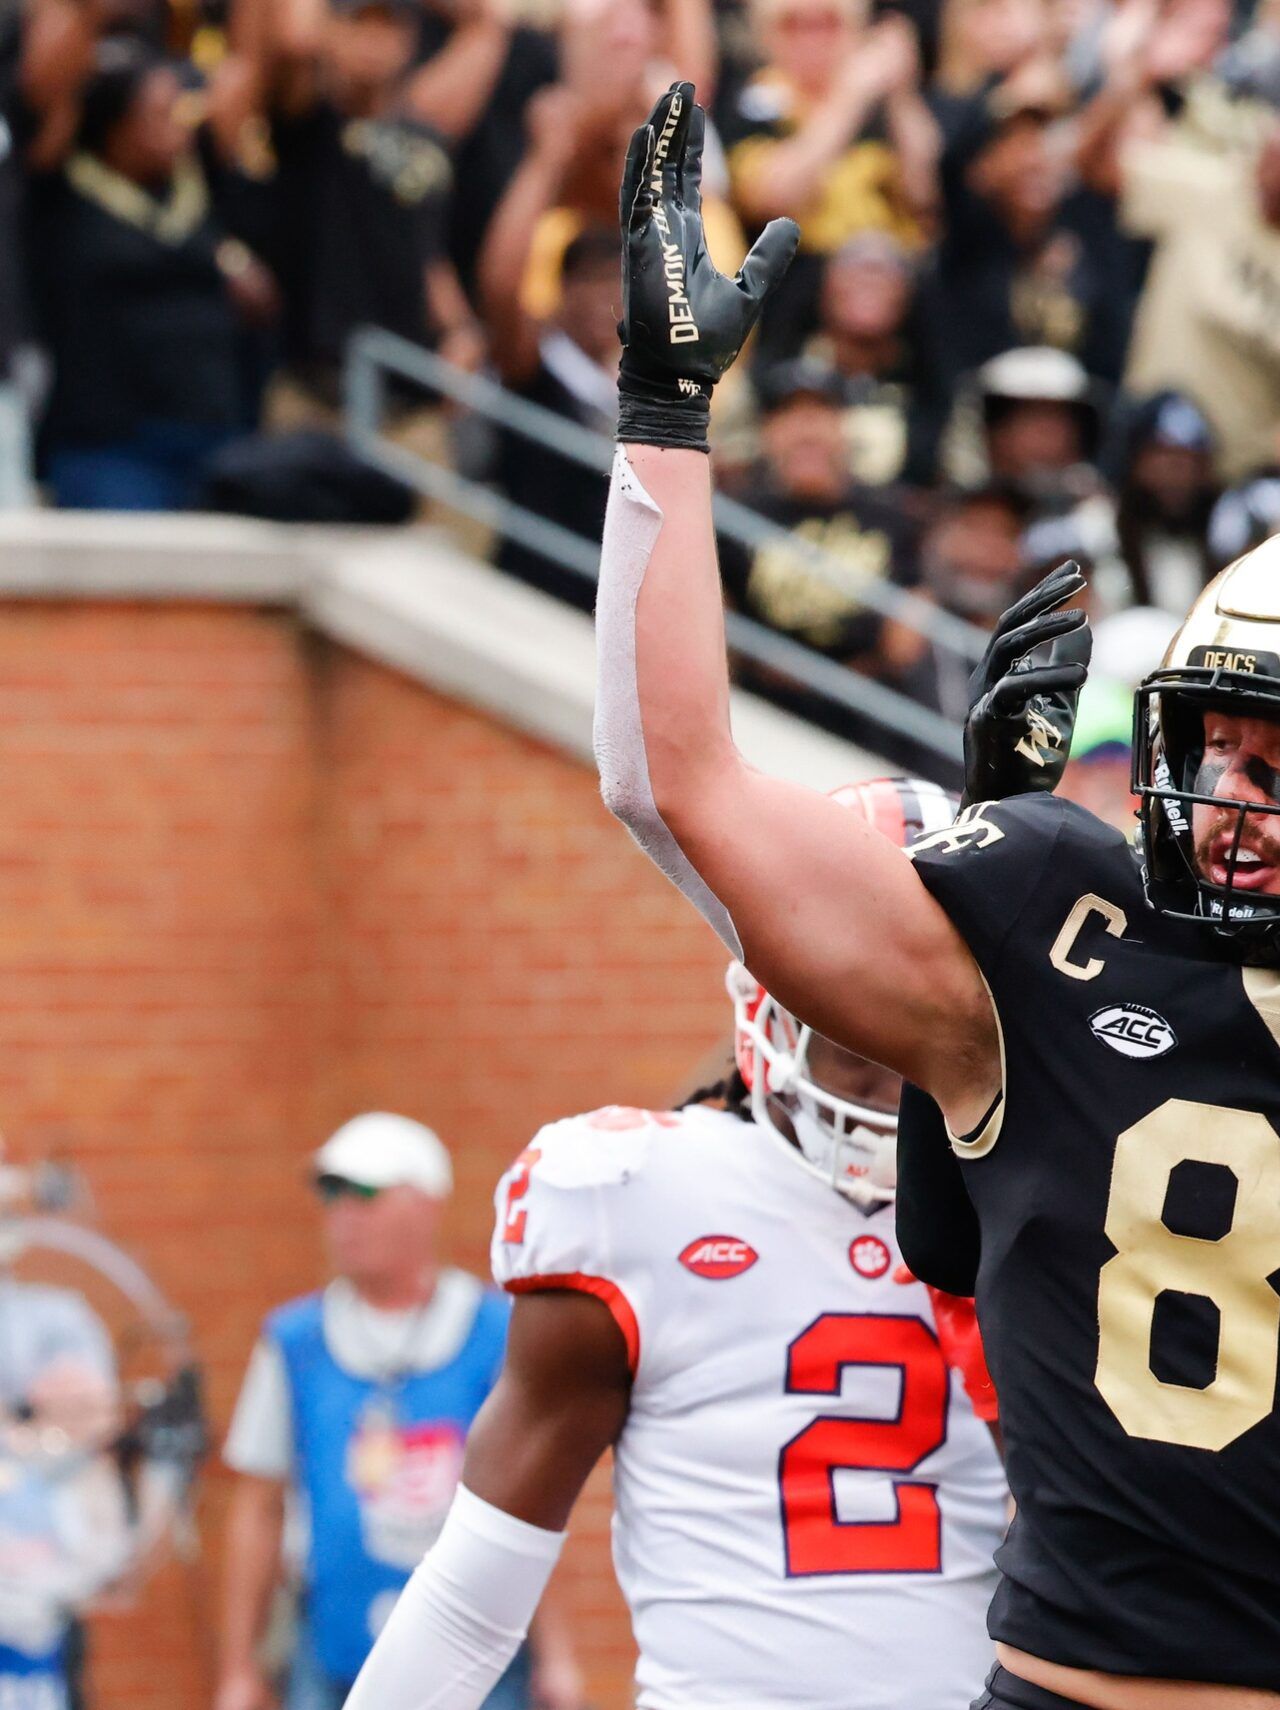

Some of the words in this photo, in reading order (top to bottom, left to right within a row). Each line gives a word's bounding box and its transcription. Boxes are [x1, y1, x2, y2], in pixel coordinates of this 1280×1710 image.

[661, 238, 700, 344] DEMON
[1203, 651, 1257, 674] DEACS
[1210, 902, 1254, 918] Ridell
[1049, 892, 1128, 982] C
[1100, 1016, 1168, 1044] ACC
[688, 1243, 749, 1264] ACC
[777, 1311, 951, 1579] 2
